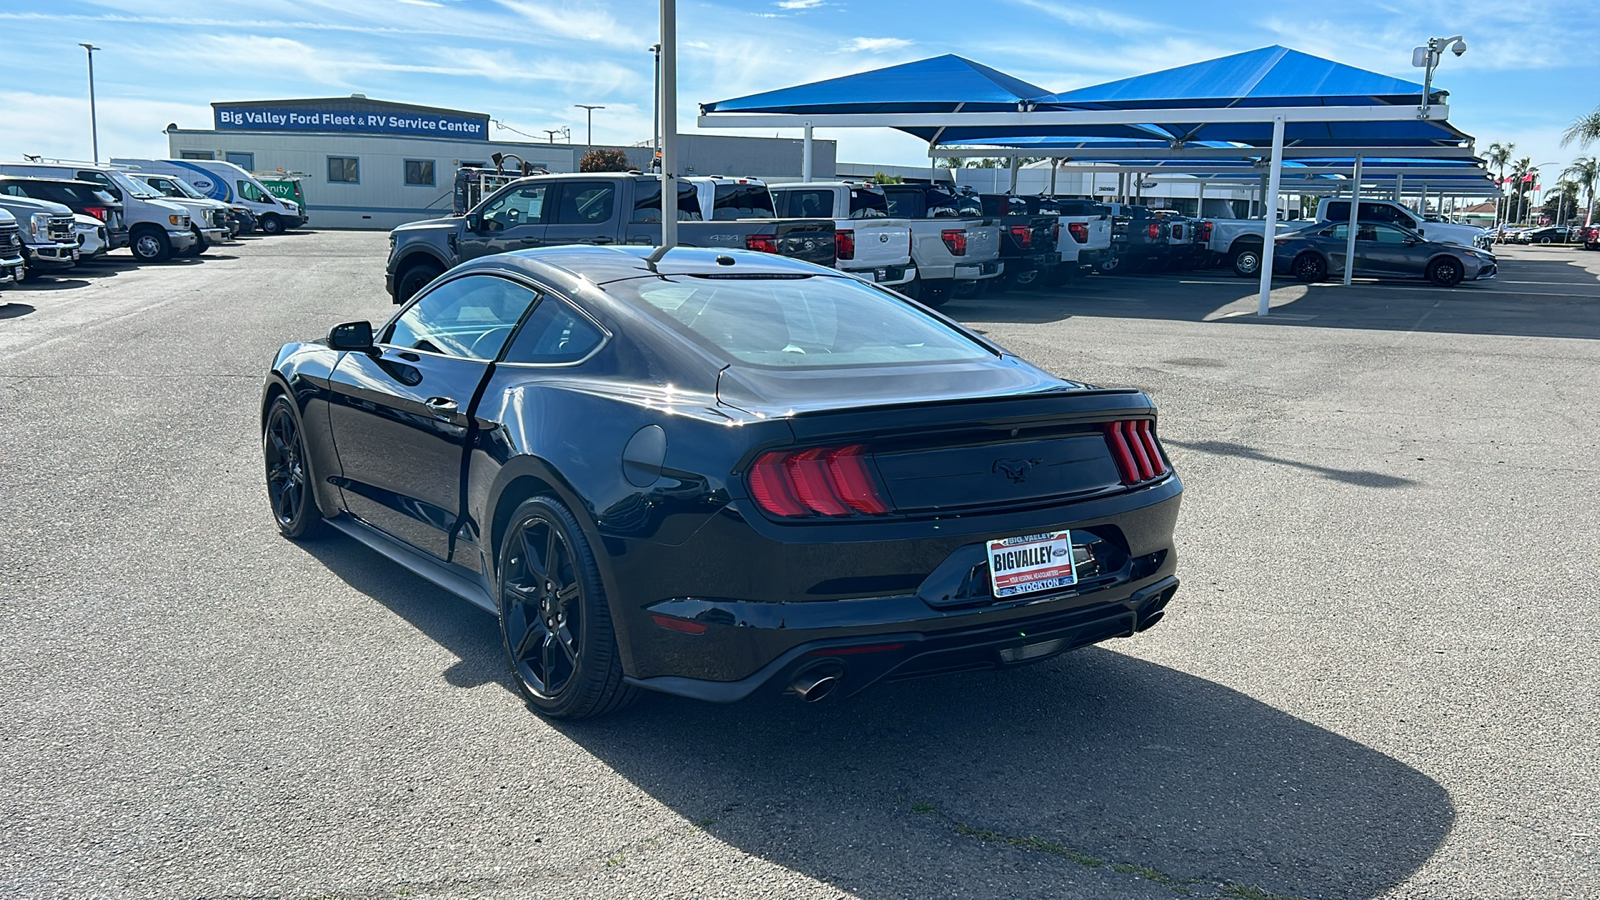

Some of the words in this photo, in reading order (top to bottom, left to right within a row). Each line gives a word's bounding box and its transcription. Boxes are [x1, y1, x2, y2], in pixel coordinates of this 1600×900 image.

[220, 111, 244, 125] Big
[245, 111, 287, 126] Valley
[289, 113, 320, 124] Ford
[322, 114, 356, 125] Fleet
[357, 117, 365, 126] &
[367, 115, 387, 127] RV
[389, 116, 436, 130] Service
[438, 120, 481, 133] Center
[1009, 536, 1023, 544] BIG
[1024, 533, 1051, 542] VALLEY
[993, 546, 1053, 572] BIGVALLEY
[1016, 578, 1060, 592] STOCKTON
